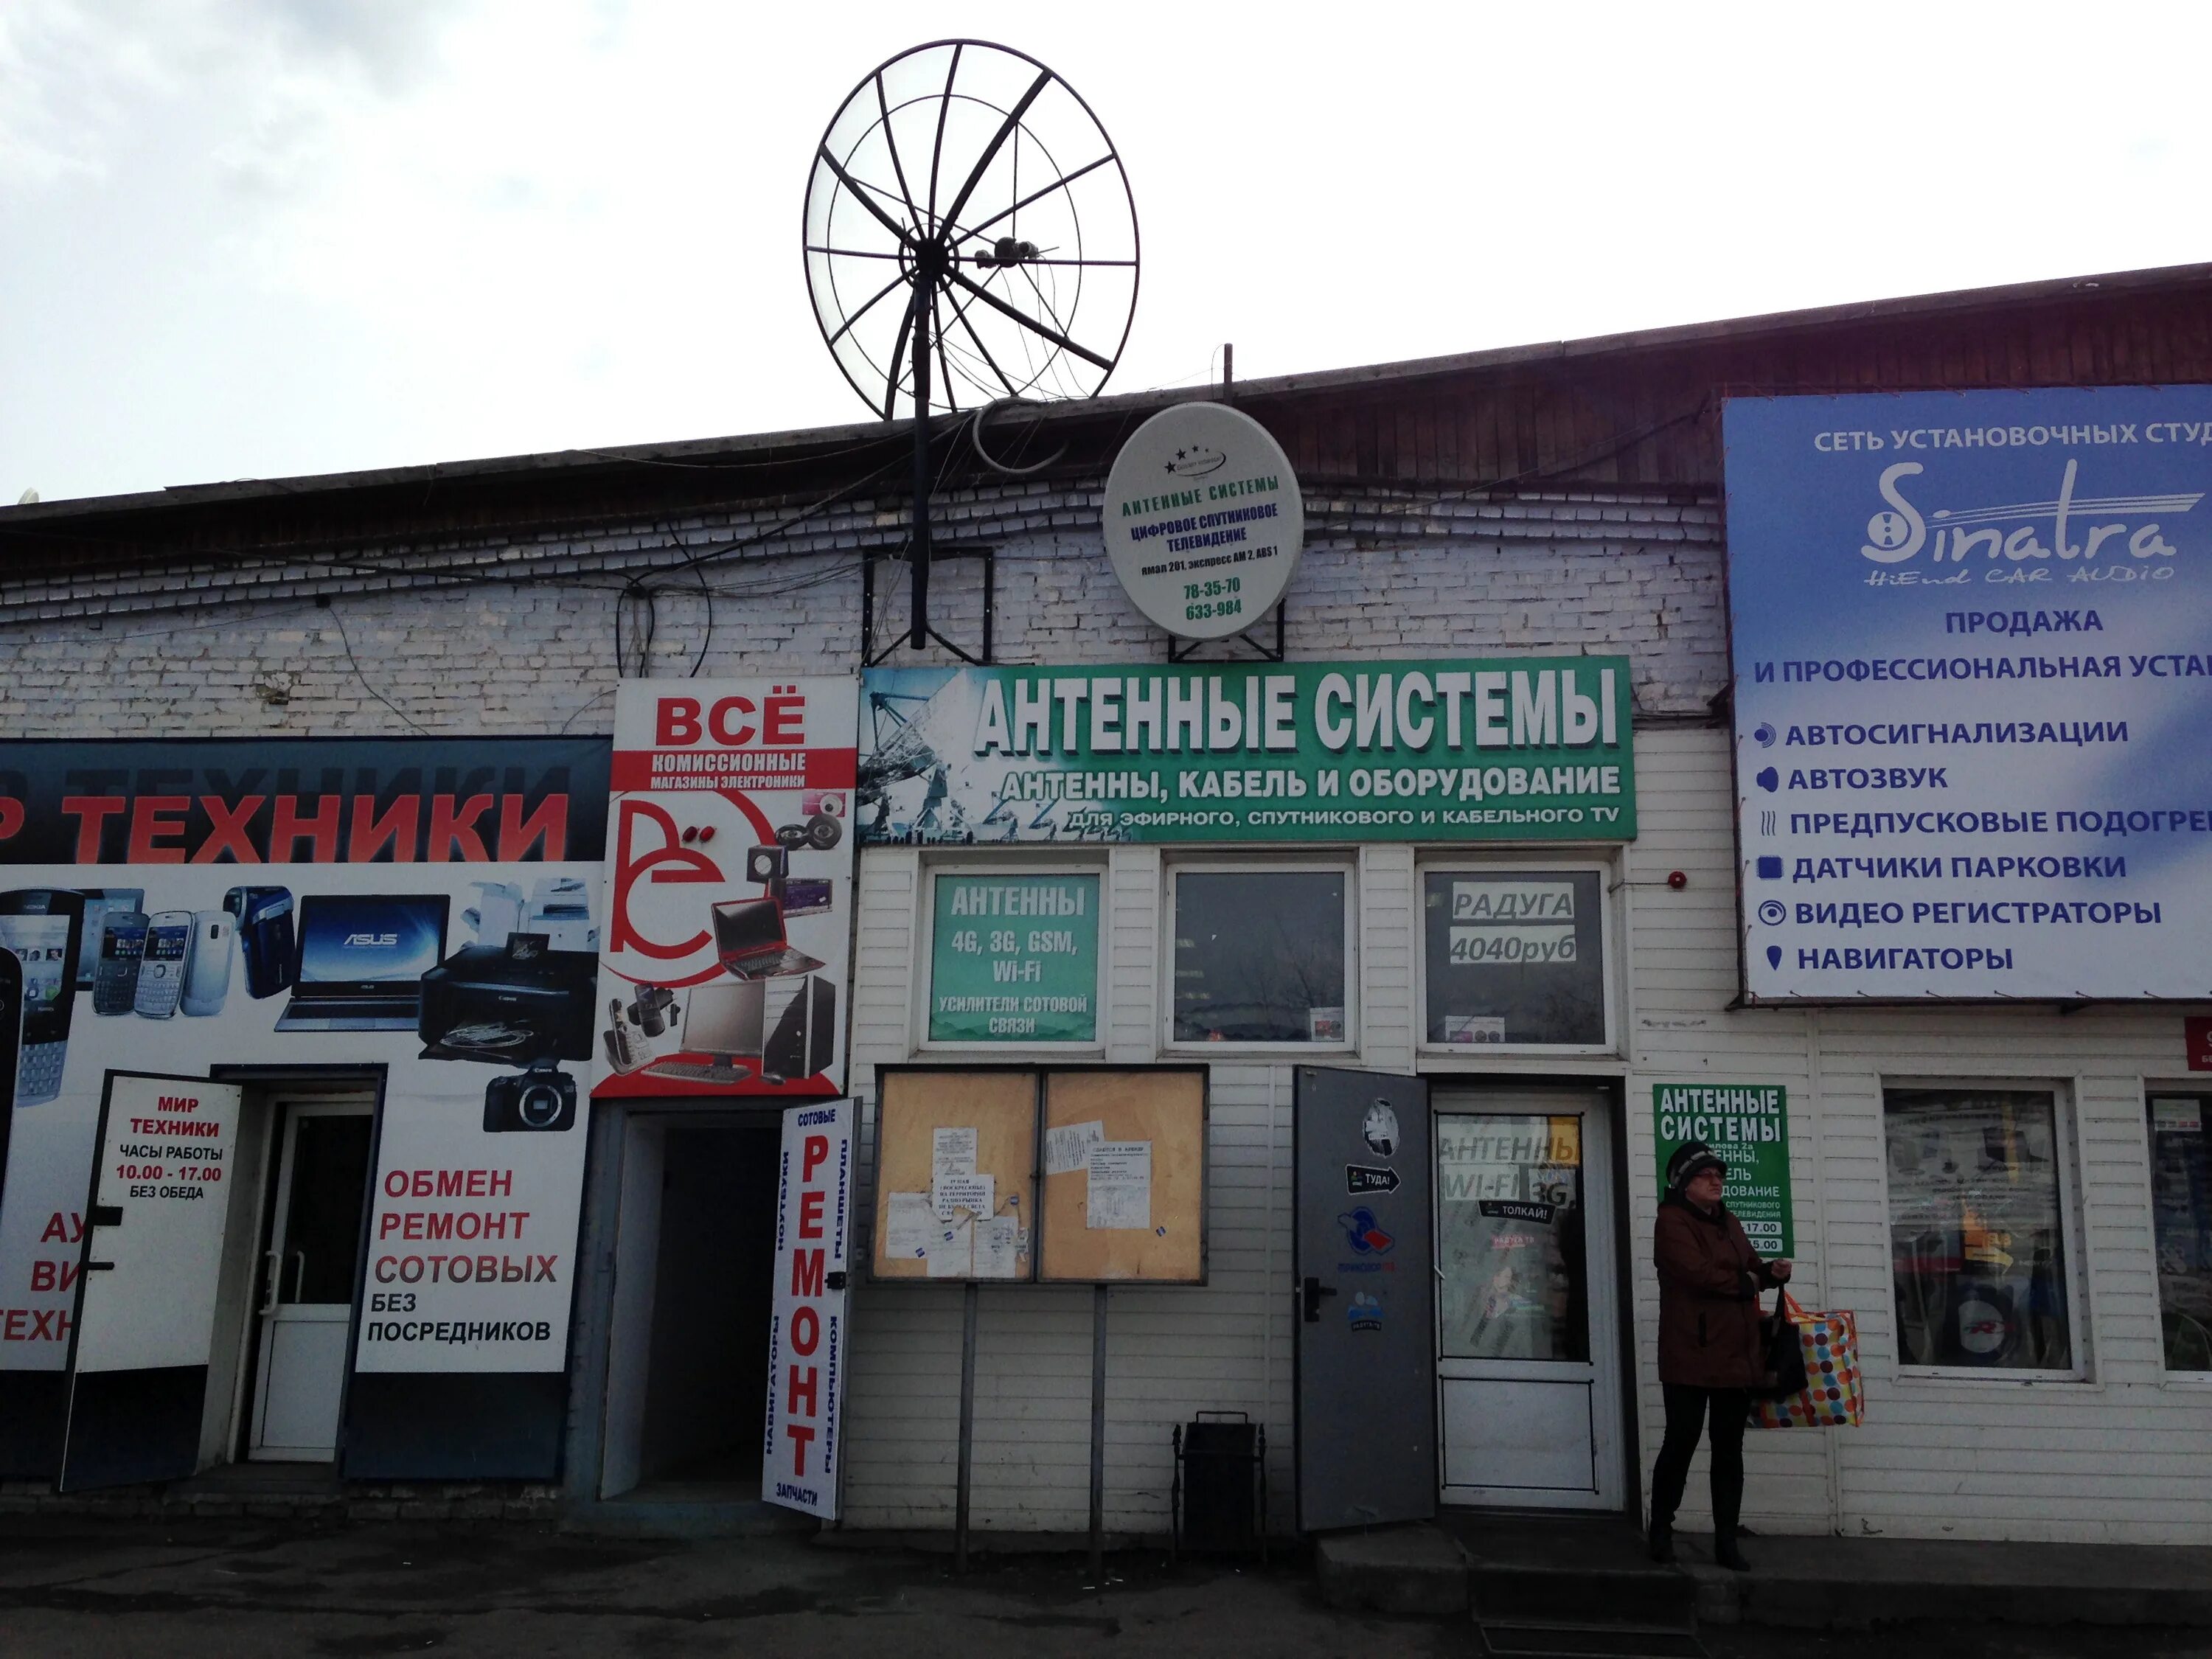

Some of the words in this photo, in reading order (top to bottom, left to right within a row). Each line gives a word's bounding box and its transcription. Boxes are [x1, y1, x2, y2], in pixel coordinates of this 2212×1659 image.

[1815, 432, 1885, 452] СЕТЬ
[1891, 424, 2138, 448] УСТАНОВОЧНЫХ
[1122, 489, 1202, 516] АНТЕННЫЕ
[1209, 476, 1279, 500] СИСТЕМЫ
[1130, 515, 1197, 542] ЦИФРОВОЕ
[1200, 503, 1278, 529] СПУТНИКОВОЕ
[1861, 459, 2177, 563] Sinatra
[1166, 527, 1247, 553] ТЕЛЕВИДЕНИЕ
[1169, 560, 1187, 572] 201,
[1985, 568, 2052, 584] CAR
[1183, 577, 1241, 599] 78-35-70
[1186, 599, 1242, 620] 633-984
[1946, 610, 2104, 638] ПРОДАЖА
[1755, 663, 1775, 683] И
[1783, 655, 2121, 683] ПРОФЕССИОНАЛЬНАЯ
[2129, 654, 2212, 678] УСТА
[655, 685, 806, 746] ВСЁ
[974, 674, 1299, 756] АНТЕННЫЕ
[1315, 668, 1620, 754] СИСТЕМЫ
[1786, 720, 2129, 747] АВТОСИГНАЛИЗАЦИИ
[651, 752, 806, 773] КОМИССИОННЫЕ
[650, 776, 719, 790] МАГАЗИНЫ
[720, 773, 805, 789] ЭЛЕКТРОНИКИ
[1001, 771, 1168, 804] АНТЕННЫ,
[1180, 769, 1307, 799] КАБЕЛЬ
[1318, 769, 1339, 797] И
[1349, 765, 1621, 801] ОБОРУДОВАНИЕ
[1788, 767, 1948, 790] АВТОЗВУК
[61, 794, 569, 864] ТЕХНИКИ
[1069, 813, 1114, 829] ДЛЯ
[1120, 811, 1240, 828] ЭФИРНОГО,
[1248, 810, 1413, 825] СПУТНИКОВОГО
[1421, 810, 1435, 824] И
[1443, 808, 1584, 824] КАБЕЛЬНОГО
[1590, 807, 1620, 821] TV
[1791, 811, 2048, 838] ПРЕДПУСКОВЫЕ
[2056, 810, 2212, 837] ПОДОГРЕ
[1792, 857, 1941, 883] ДАТЧИКИ
[1952, 857, 2126, 878] ПАРКОВКИ
[951, 886, 1085, 916] АНТЕННЫ
[1453, 892, 1573, 919] РАДУГА
[1795, 902, 1903, 928] ВИДЕО
[1913, 901, 2161, 925] РЕГИСТРАТОРЫ
[344, 933, 398, 946] ASUS
[951, 931, 983, 956] 4G,
[990, 931, 1021, 956] 3G,
[1028, 931, 1078, 956] GSM,
[1450, 933, 1576, 962] 4040руб
[993, 960, 1041, 982] Wi-Fi
[1798, 947, 2013, 970] НАВИГАТОРЫ
[939, 997, 1020, 1013] УСИЛИТЕЛИ
[1023, 993, 1088, 1013] СОТОВОЙ
[989, 1018, 1035, 1033] СВЯЗИ
[158, 1096, 199, 1113] МИР
[1660, 1089, 1780, 1114] АНТЕННЫЕ
[130, 1118, 219, 1138] ТЕХНИКИ
[798, 1108, 836, 1127] СОТОВЫЕ
[1660, 1115, 1781, 1142] СИСТЕМЫ
[119, 1144, 161, 1158] ЧАСЫ
[166, 1146, 223, 1161] РАБОТЫ
[1439, 1136, 1580, 1162] АНТЕННЫ
[1714, 1150, 1759, 1164] ЕННЫ,
[116, 1164, 162, 1180] 10.00
[178, 1166, 221, 1182] 17.00
[384, 1169, 512, 1197] ОБМЕН
[1365, 1173, 1390, 1186] ТУДА!
[1726, 1167, 1752, 1180] ЕЛЬ
[130, 1185, 156, 1198] БЕЗ
[159, 1186, 204, 1200] ОБЕДА
[834, 1139, 847, 1259] ПЛАНШЕТЫ
[1721, 1185, 1780, 1197] ДОВАНИЕ
[1502, 1205, 1548, 1220] ТОЛКАЙ!
[41, 1213, 86, 1243] АУ
[379, 1212, 530, 1239] РЕМОНТ
[31, 1261, 80, 1292] ВИ
[375, 1255, 558, 1283] СОТОВЫХ
[371, 1293, 416, 1312] БЕЗ
[787, 1135, 829, 1477] РЕМОНТ
[368, 1321, 551, 1345] ПОСРЕДНИКОВ
[766, 1315, 779, 1455] НАВИГАТОРЫ
[824, 1315, 838, 1474] КОМПЬЮТЕРЫ
[776, 1482, 818, 1506] ЗАПЧАСТИ
